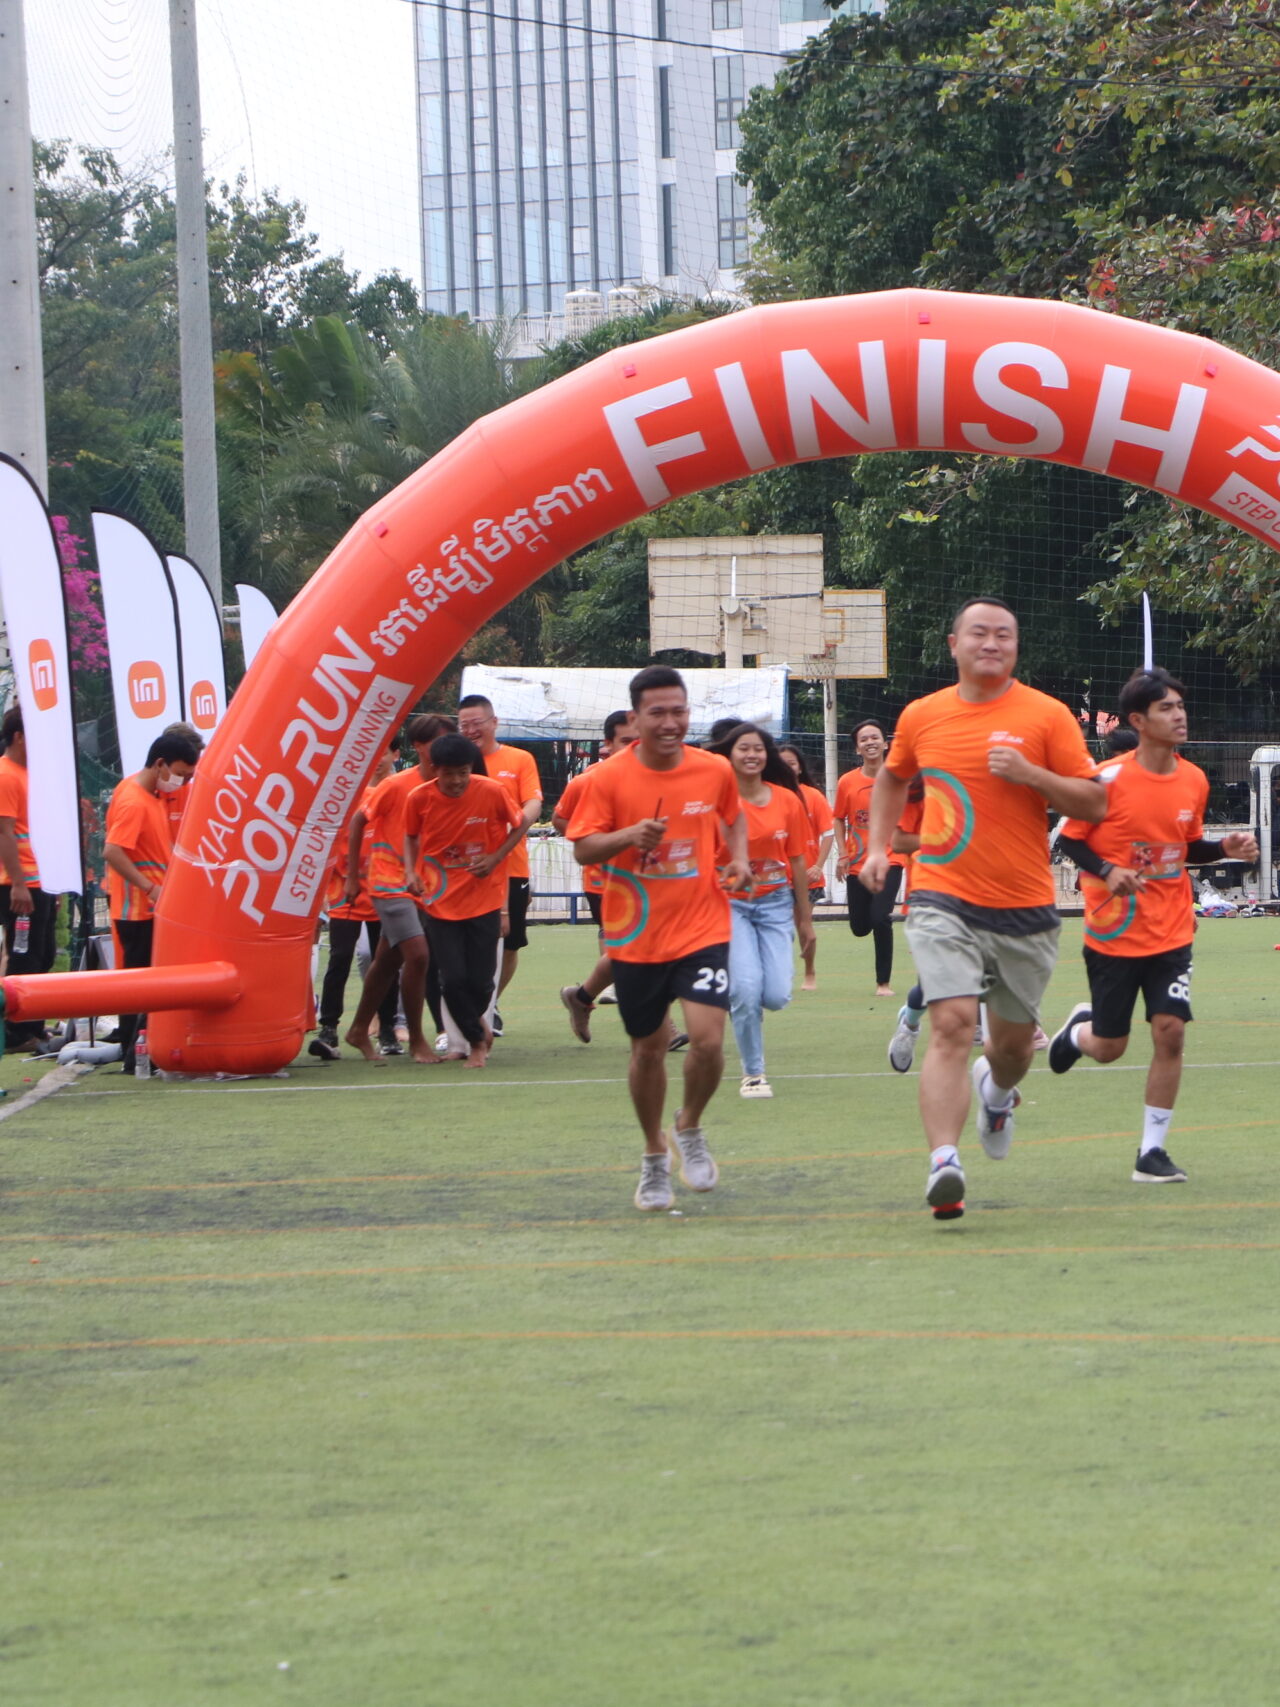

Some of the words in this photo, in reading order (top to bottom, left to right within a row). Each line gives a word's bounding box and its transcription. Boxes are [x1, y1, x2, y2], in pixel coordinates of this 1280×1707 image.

[602, 339, 1208, 508] FINISH
[1228, 491, 1275, 529] STEP
[194, 744, 261, 887] XIAOMI
[222, 772, 301, 926] POP
[280, 626, 376, 786] RUN
[290, 854, 317, 902] STEP
[306, 825, 328, 853] UP
[317, 776, 354, 825] YOUR
[343, 690, 397, 773] RUNNING
[692, 966, 728, 994] 29
